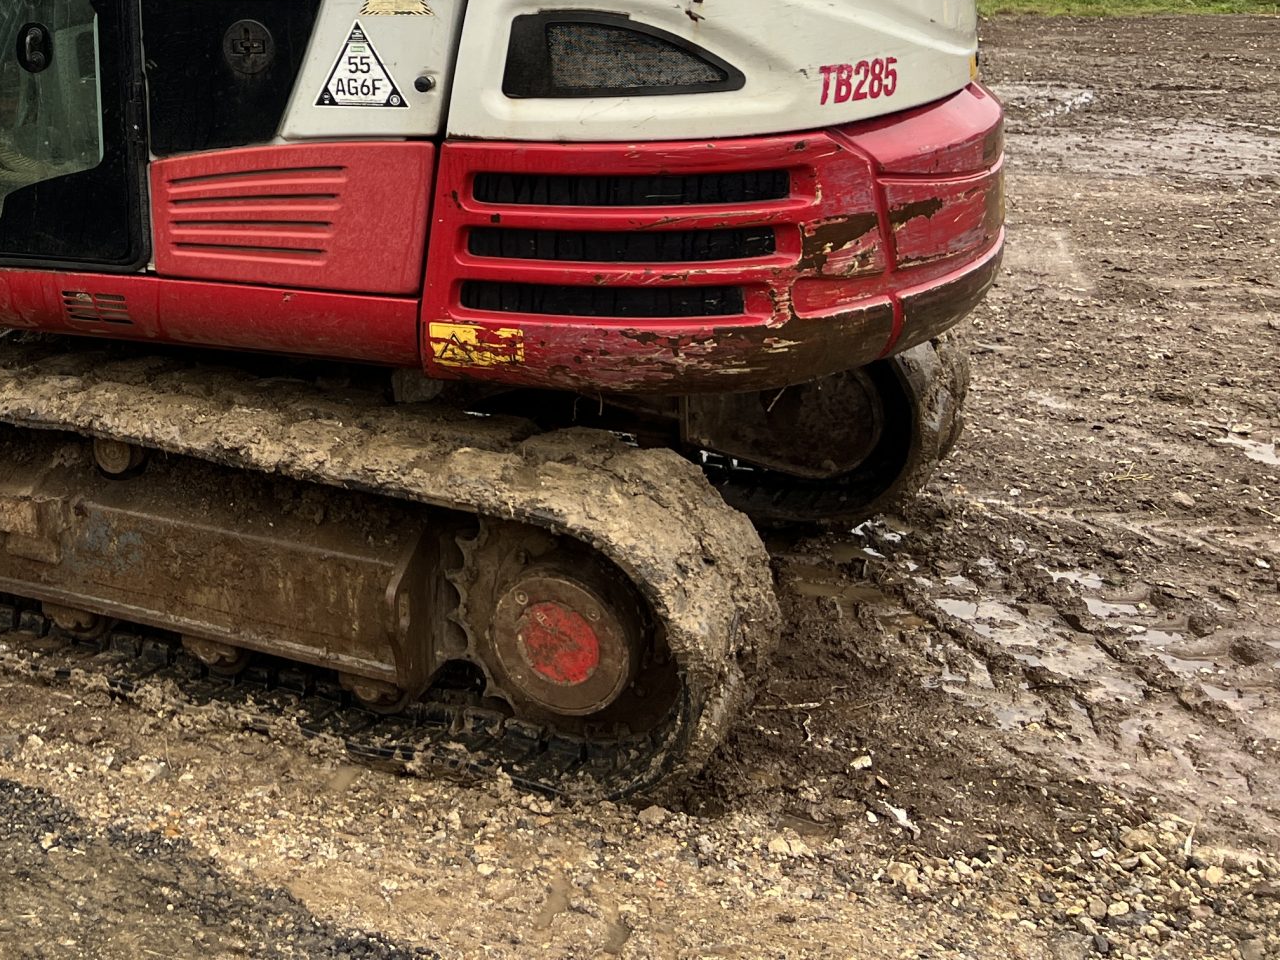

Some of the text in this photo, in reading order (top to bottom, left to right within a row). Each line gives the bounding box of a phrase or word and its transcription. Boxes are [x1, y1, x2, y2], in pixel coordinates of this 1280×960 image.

[348, 56, 371, 74] 55
[335, 78, 383, 96] AG6F
[819, 56, 898, 105] TB285
